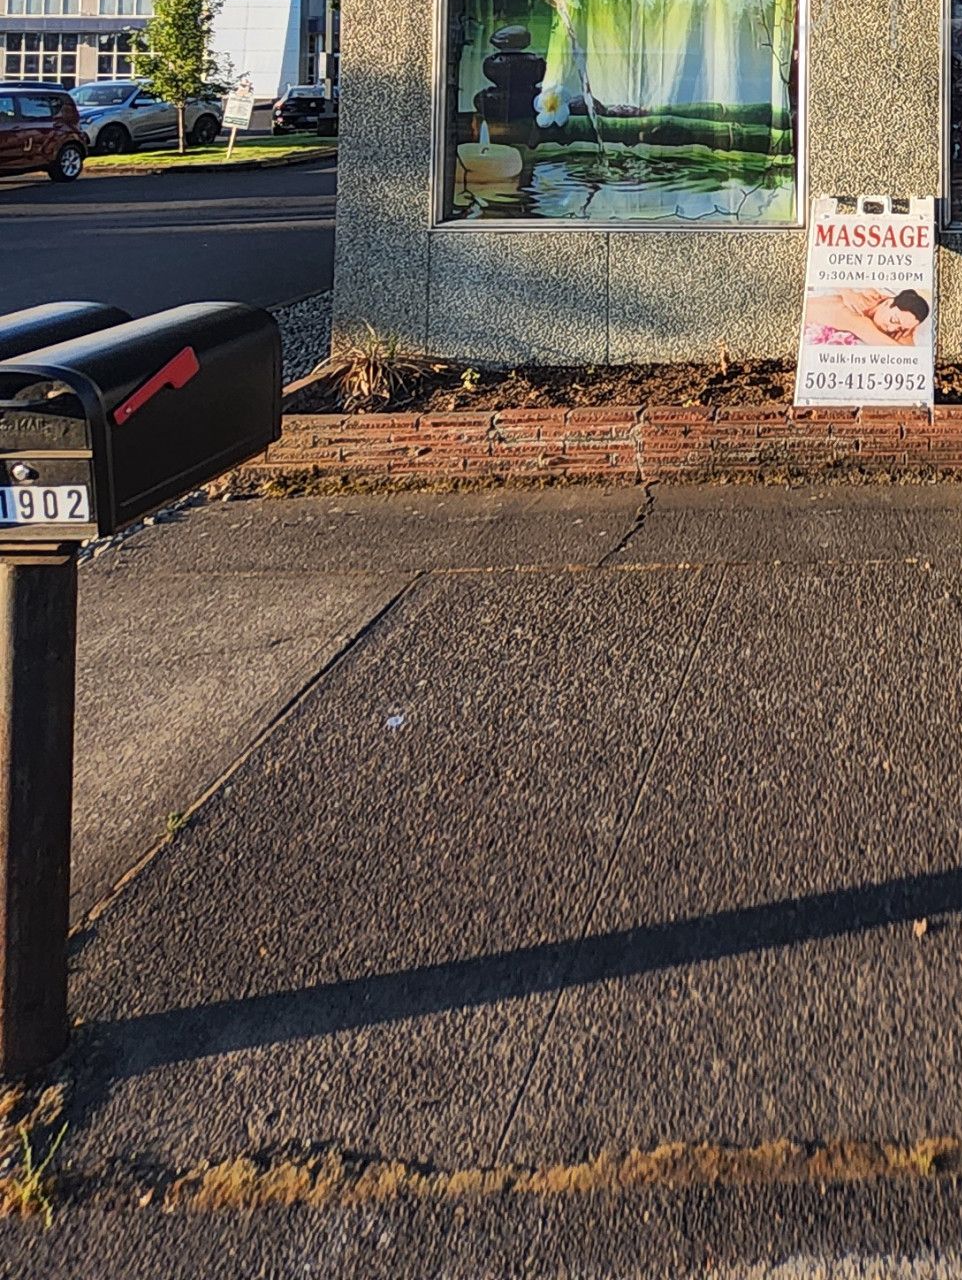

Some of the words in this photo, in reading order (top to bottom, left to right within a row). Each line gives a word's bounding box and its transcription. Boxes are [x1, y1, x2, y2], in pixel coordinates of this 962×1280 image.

[815, 224, 930, 248] MASSAGE
[829, 253, 863, 265] OPEN
[867, 254, 874, 265] 7
[878, 254, 912, 266] DAYS
[818, 271, 924, 281] 9:30AM-10:30PM
[819, 353, 866, 364] Walk-Ins
[870, 354, 918, 365] Welcome
[805, 372, 926, 390] 503-415-9952
